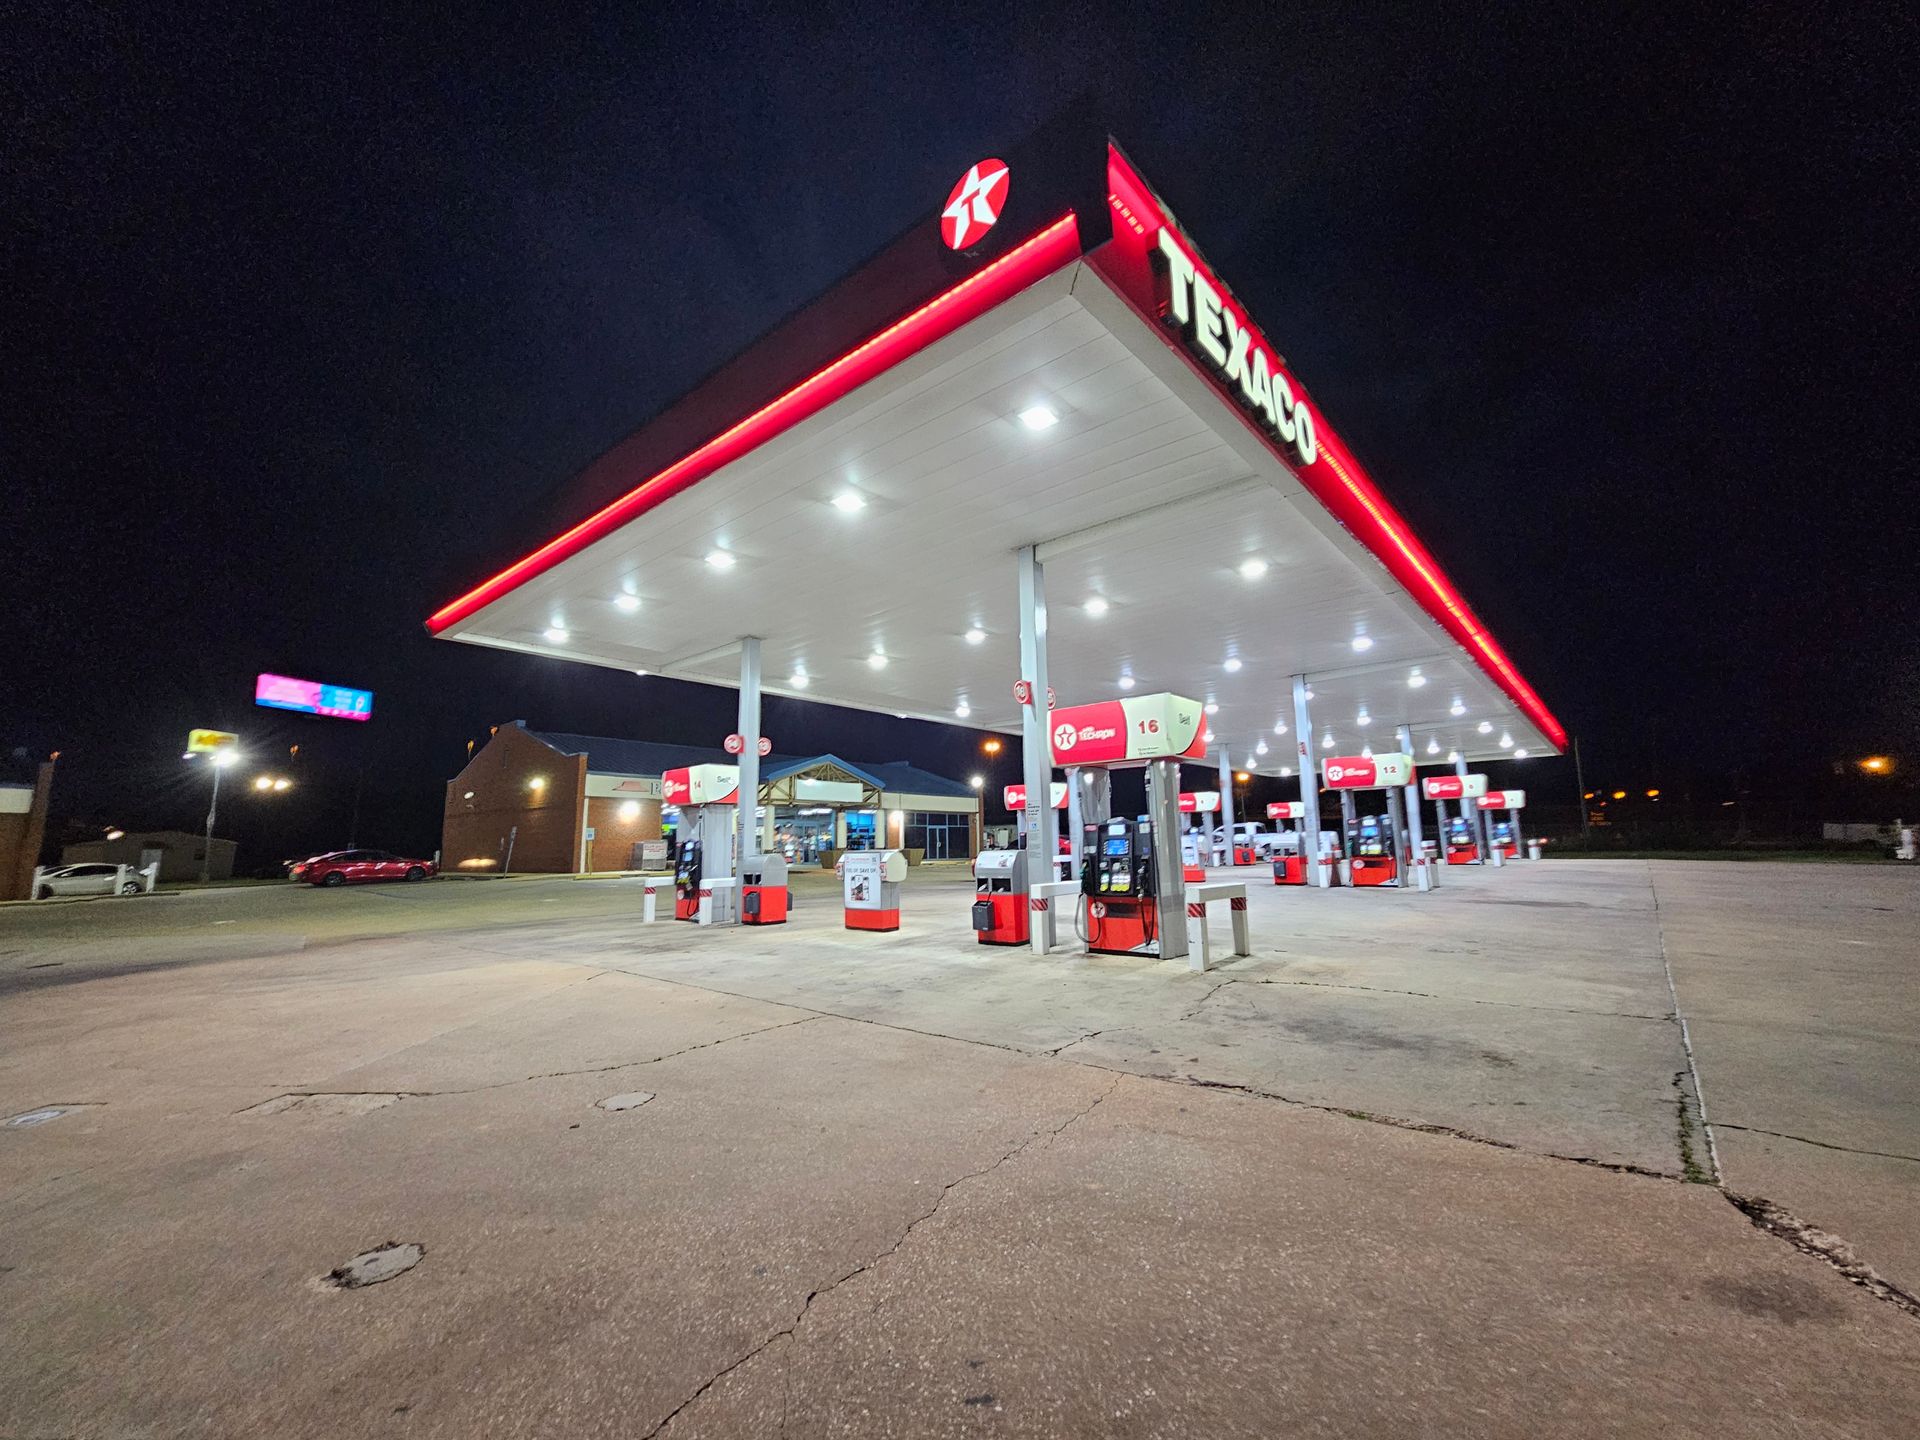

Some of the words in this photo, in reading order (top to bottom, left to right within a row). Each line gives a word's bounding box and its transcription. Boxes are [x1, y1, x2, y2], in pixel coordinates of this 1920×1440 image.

[1158, 226, 1317, 465] TEXACO
[1138, 719, 1159, 734] 16
[1383, 766, 1397, 774] 12
[694, 780, 701, 789] 14
